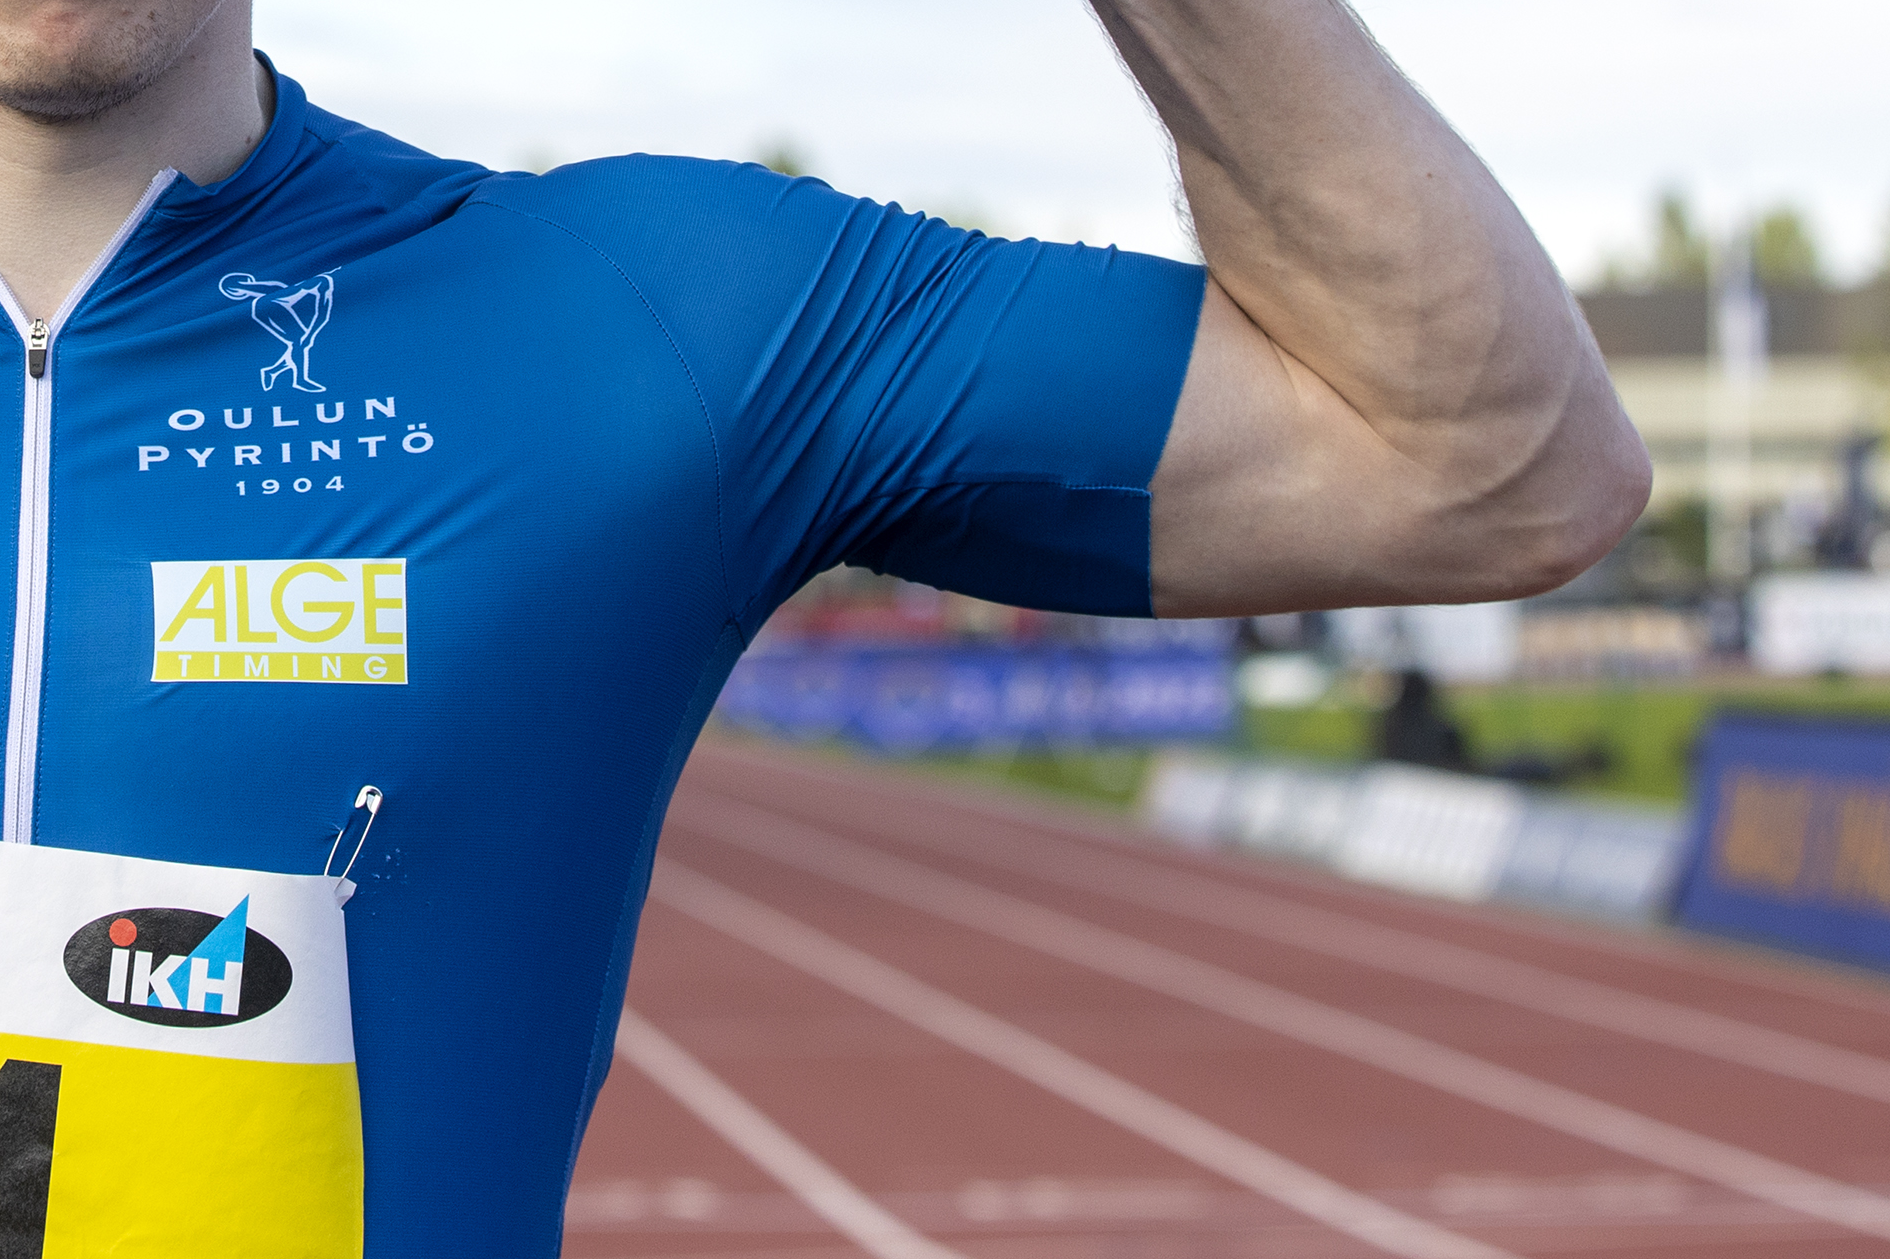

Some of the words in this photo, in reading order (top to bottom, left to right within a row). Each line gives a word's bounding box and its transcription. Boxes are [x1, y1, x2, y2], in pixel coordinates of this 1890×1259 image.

[167, 396, 397, 431] OULUN
[137, 422, 435, 471] PYRINTÖ
[235, 475, 345, 496] 1904
[158, 561, 404, 645] ALGE
[178, 654, 388, 680] TIMING
